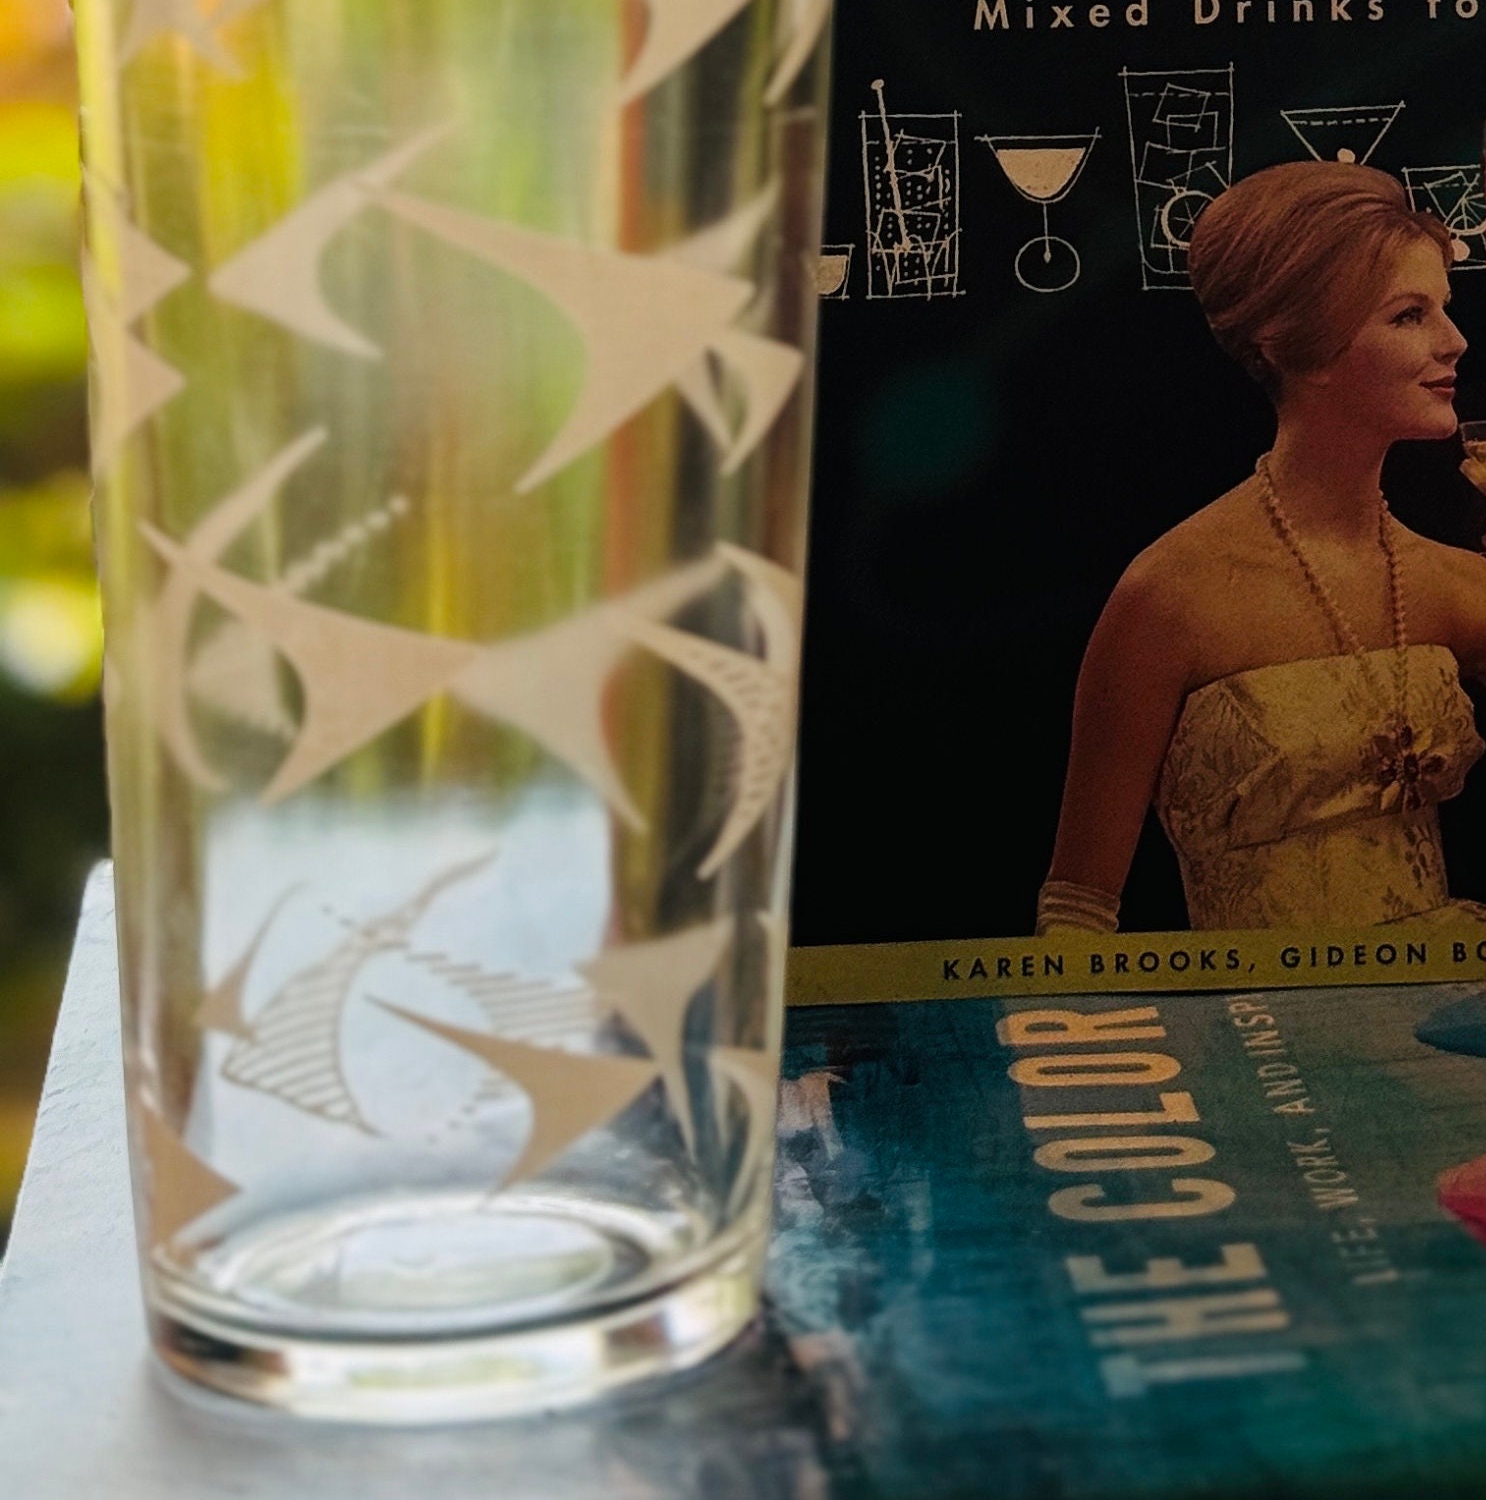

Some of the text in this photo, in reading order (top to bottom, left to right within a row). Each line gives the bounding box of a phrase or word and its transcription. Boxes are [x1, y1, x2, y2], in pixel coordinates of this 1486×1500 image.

[943, 953, 1065, 981] KAREN
[1090, 948, 1257, 975] BROOKS,
[1280, 943, 1427, 969] GIDEON
[1256, 1061, 1316, 1116] AND
[1000, 1006, 1308, 1398] THE COLOR
[1286, 1126, 1360, 1210] WORK,
